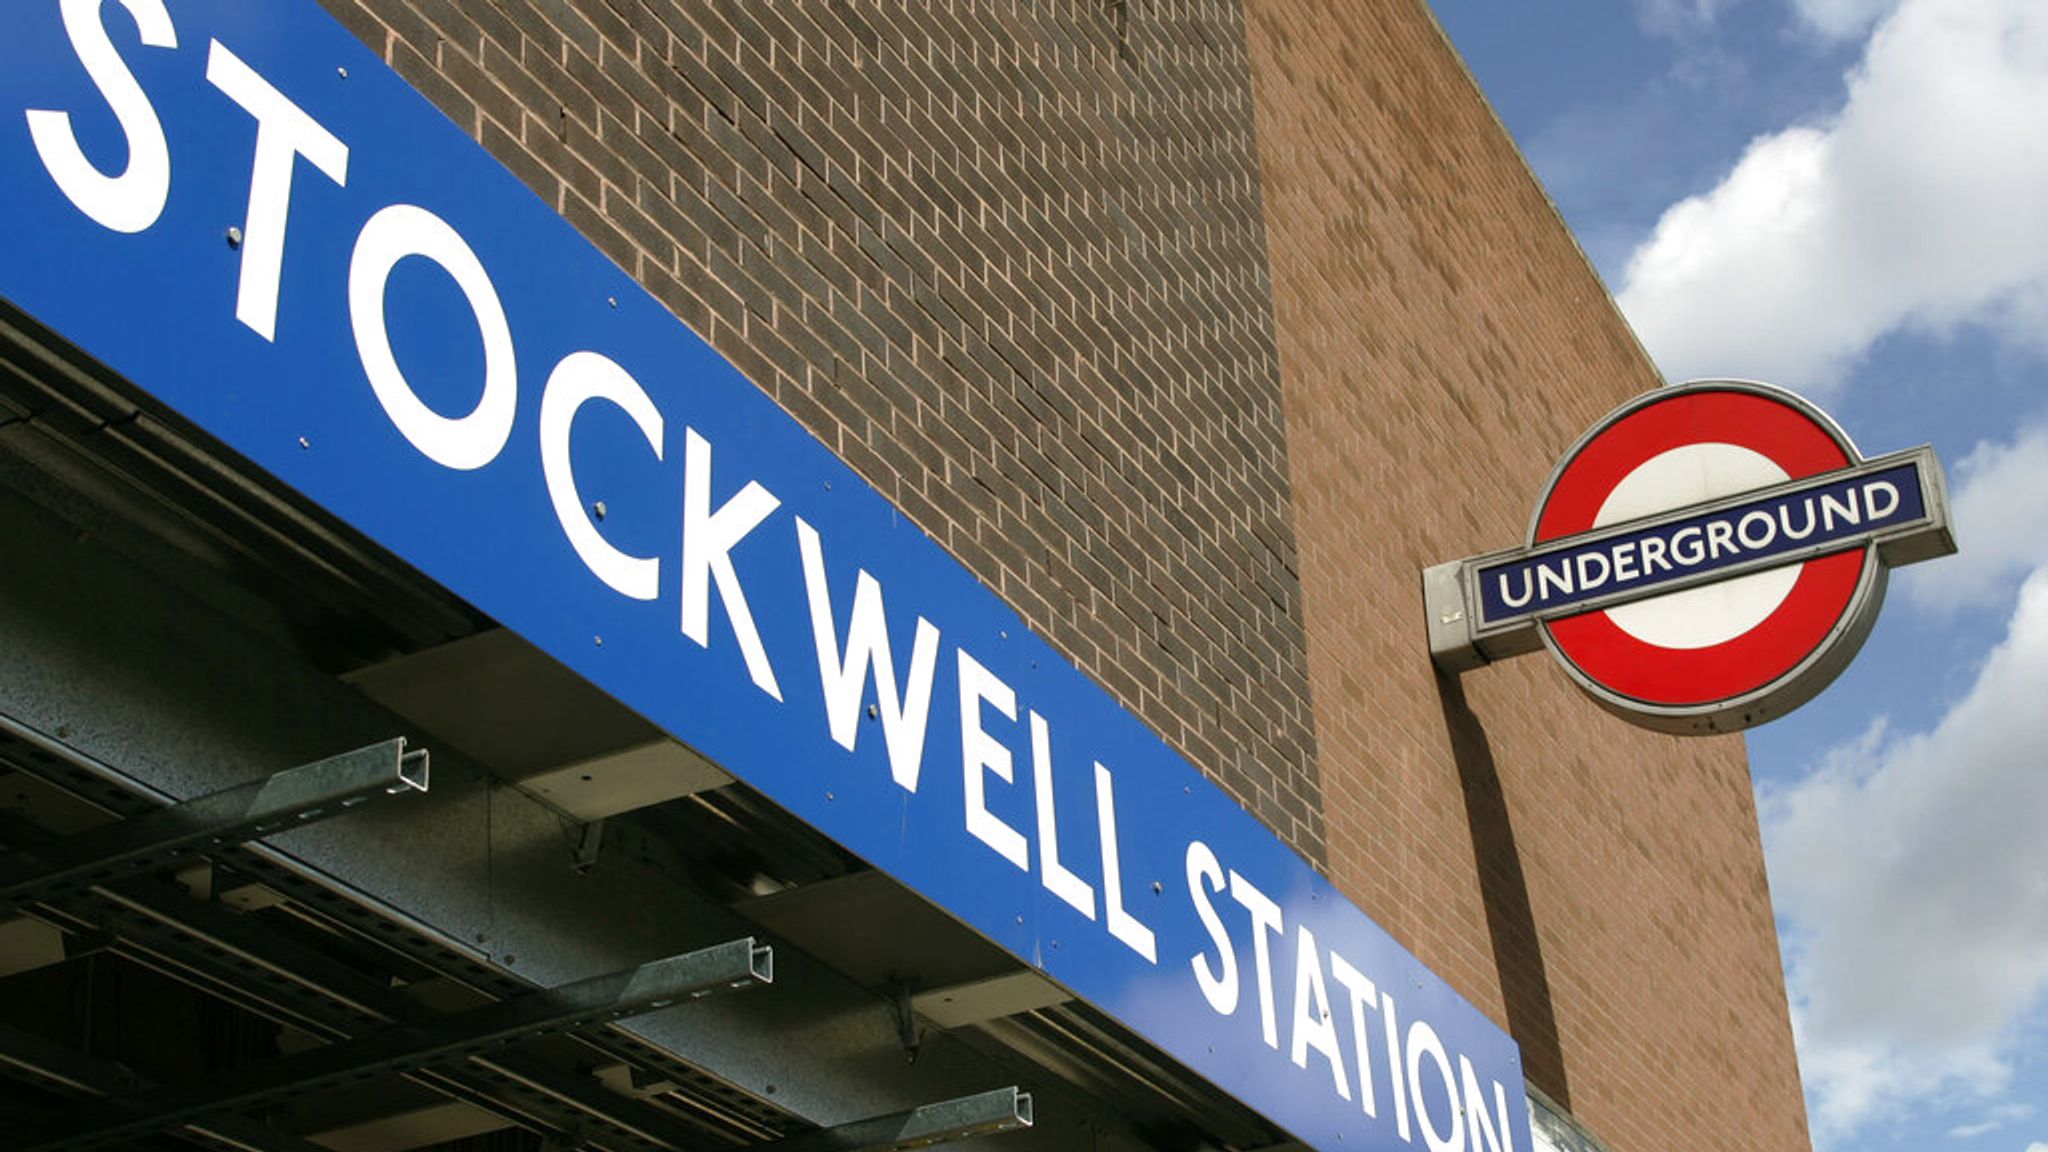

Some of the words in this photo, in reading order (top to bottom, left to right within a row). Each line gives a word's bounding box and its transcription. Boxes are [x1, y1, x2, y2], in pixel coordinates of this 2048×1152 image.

[26, 0, 1158, 965] STOCKWELL
[1186, 840, 1514, 1152] STATION
[1499, 481, 1899, 608] UNDERGROUND
